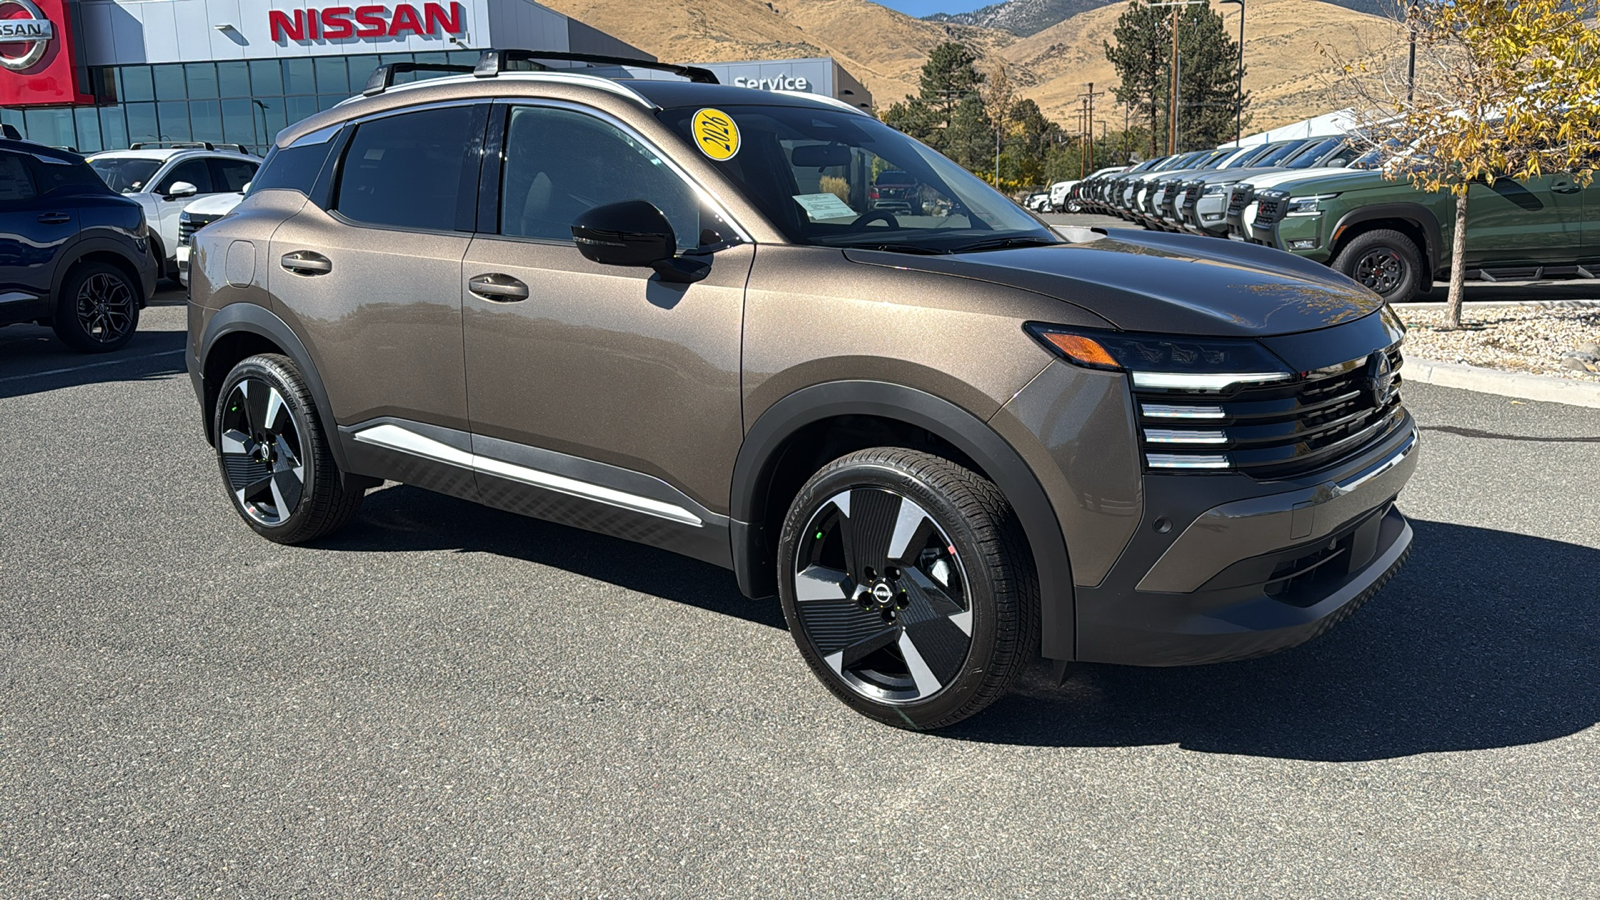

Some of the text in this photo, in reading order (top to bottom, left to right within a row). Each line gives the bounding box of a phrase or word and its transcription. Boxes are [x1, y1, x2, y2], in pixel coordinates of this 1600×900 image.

[0, 24, 41, 36] SAN
[269, 2, 461, 41] NISSAN
[734, 74, 807, 90] Service
[702, 112, 730, 152] 2026
[901, 476, 967, 538] BRIDGESTONE
